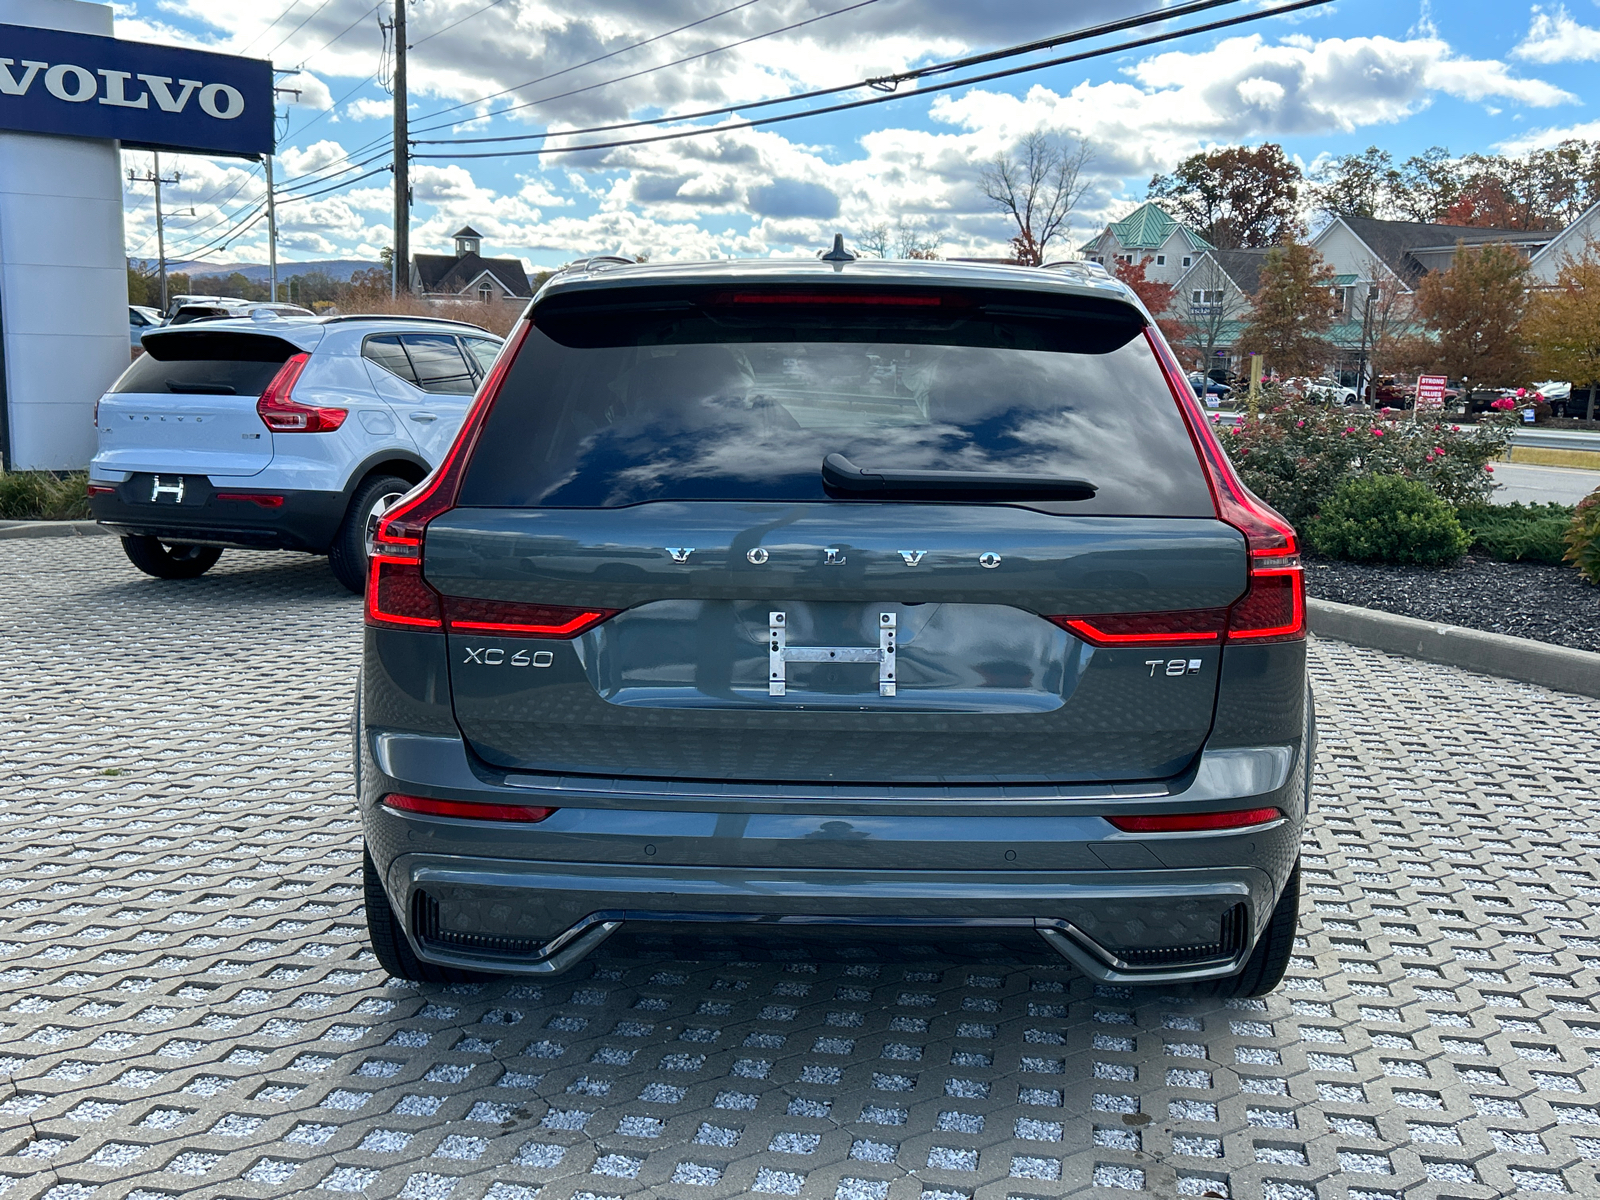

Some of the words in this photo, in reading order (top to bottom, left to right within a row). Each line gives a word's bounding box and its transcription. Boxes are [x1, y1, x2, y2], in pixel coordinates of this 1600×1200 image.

[0, 58, 245, 120] VOLVO
[129, 415, 203, 423] VOLVO
[665, 547, 1001, 569] VOLVO
